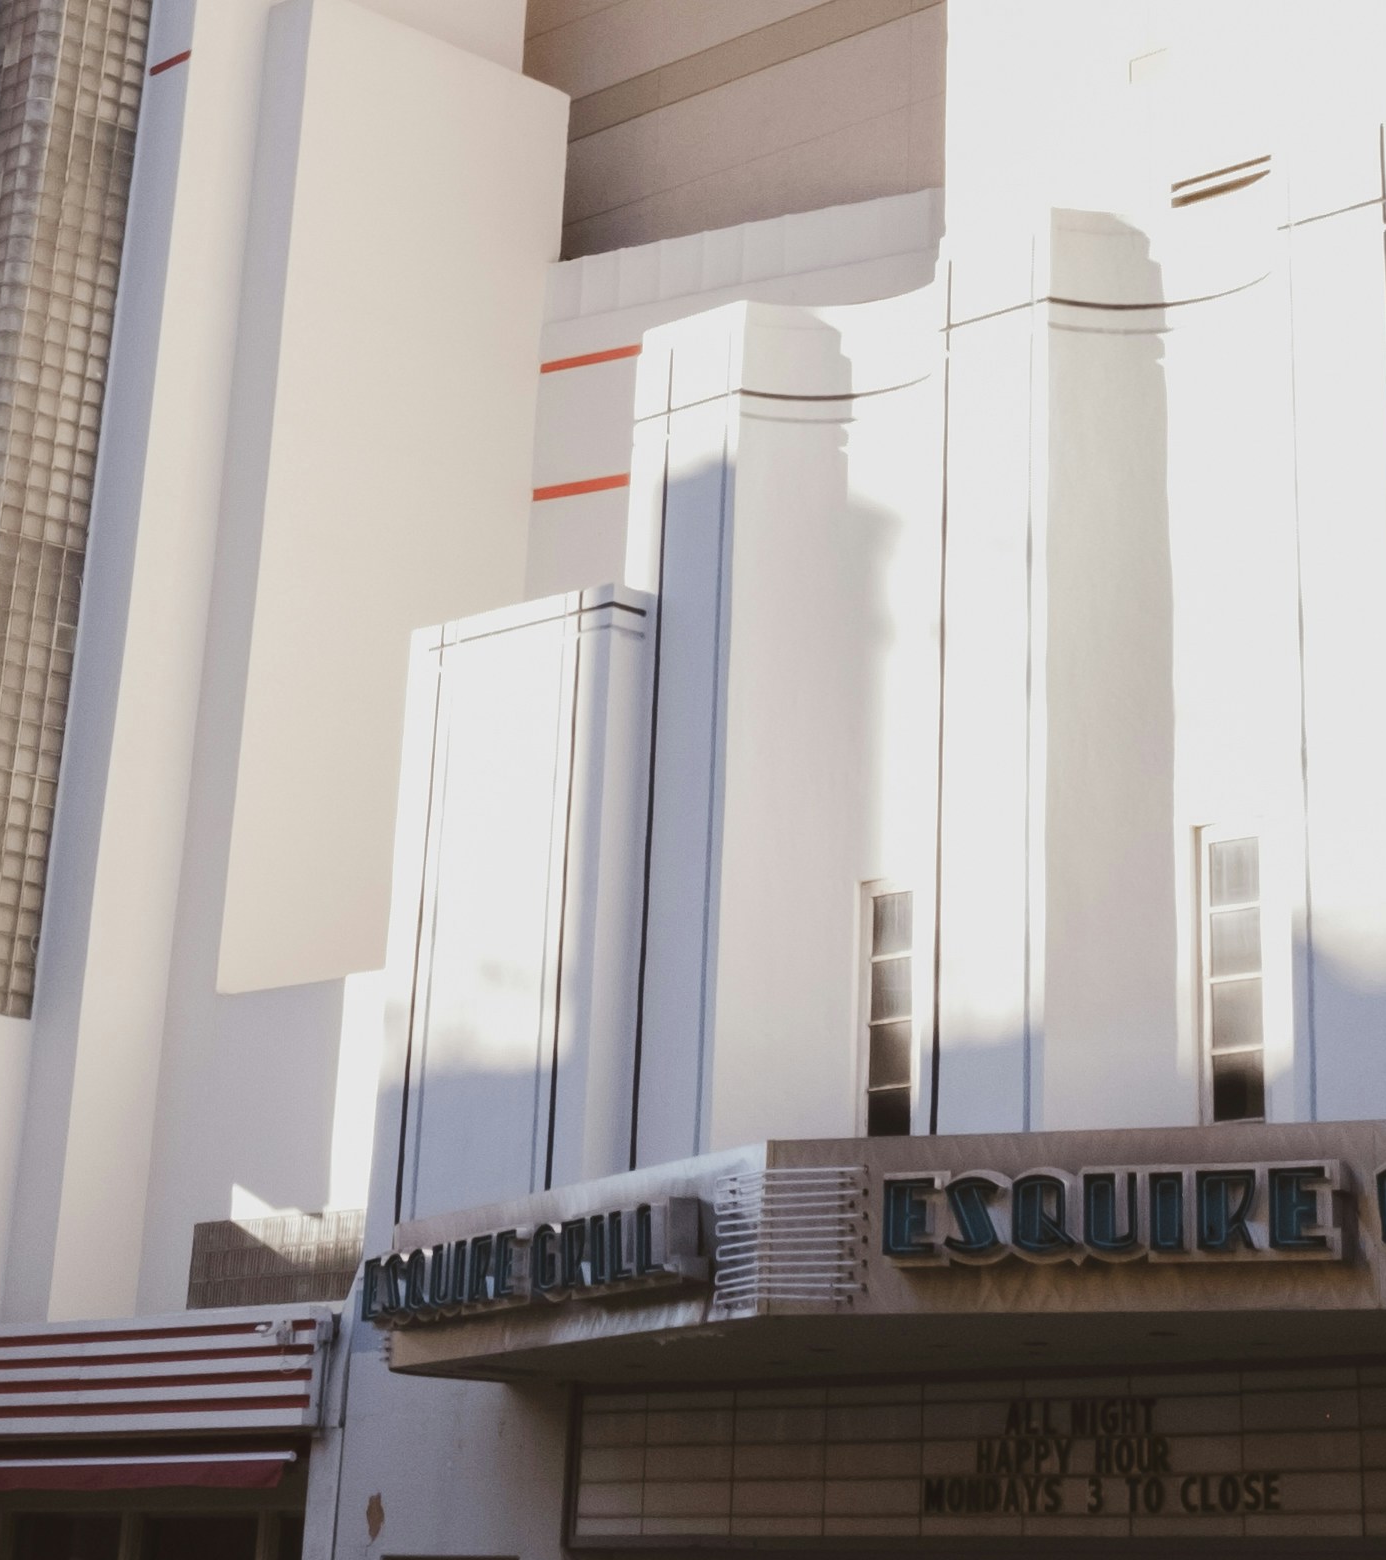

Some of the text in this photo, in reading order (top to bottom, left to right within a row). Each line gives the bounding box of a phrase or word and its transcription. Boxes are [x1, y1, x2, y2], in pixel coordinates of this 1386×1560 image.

[882, 1165, 1330, 1255] ESQUIRE
[362, 1204, 665, 1321] ESQUIRE GRILL
[1004, 1397, 1157, 1436] ALL NIGHT
[976, 1436, 1172, 1475] HAPPY HOUR
[924, 1474, 1281, 1513] MONDAYS 3 TO CLOSE
